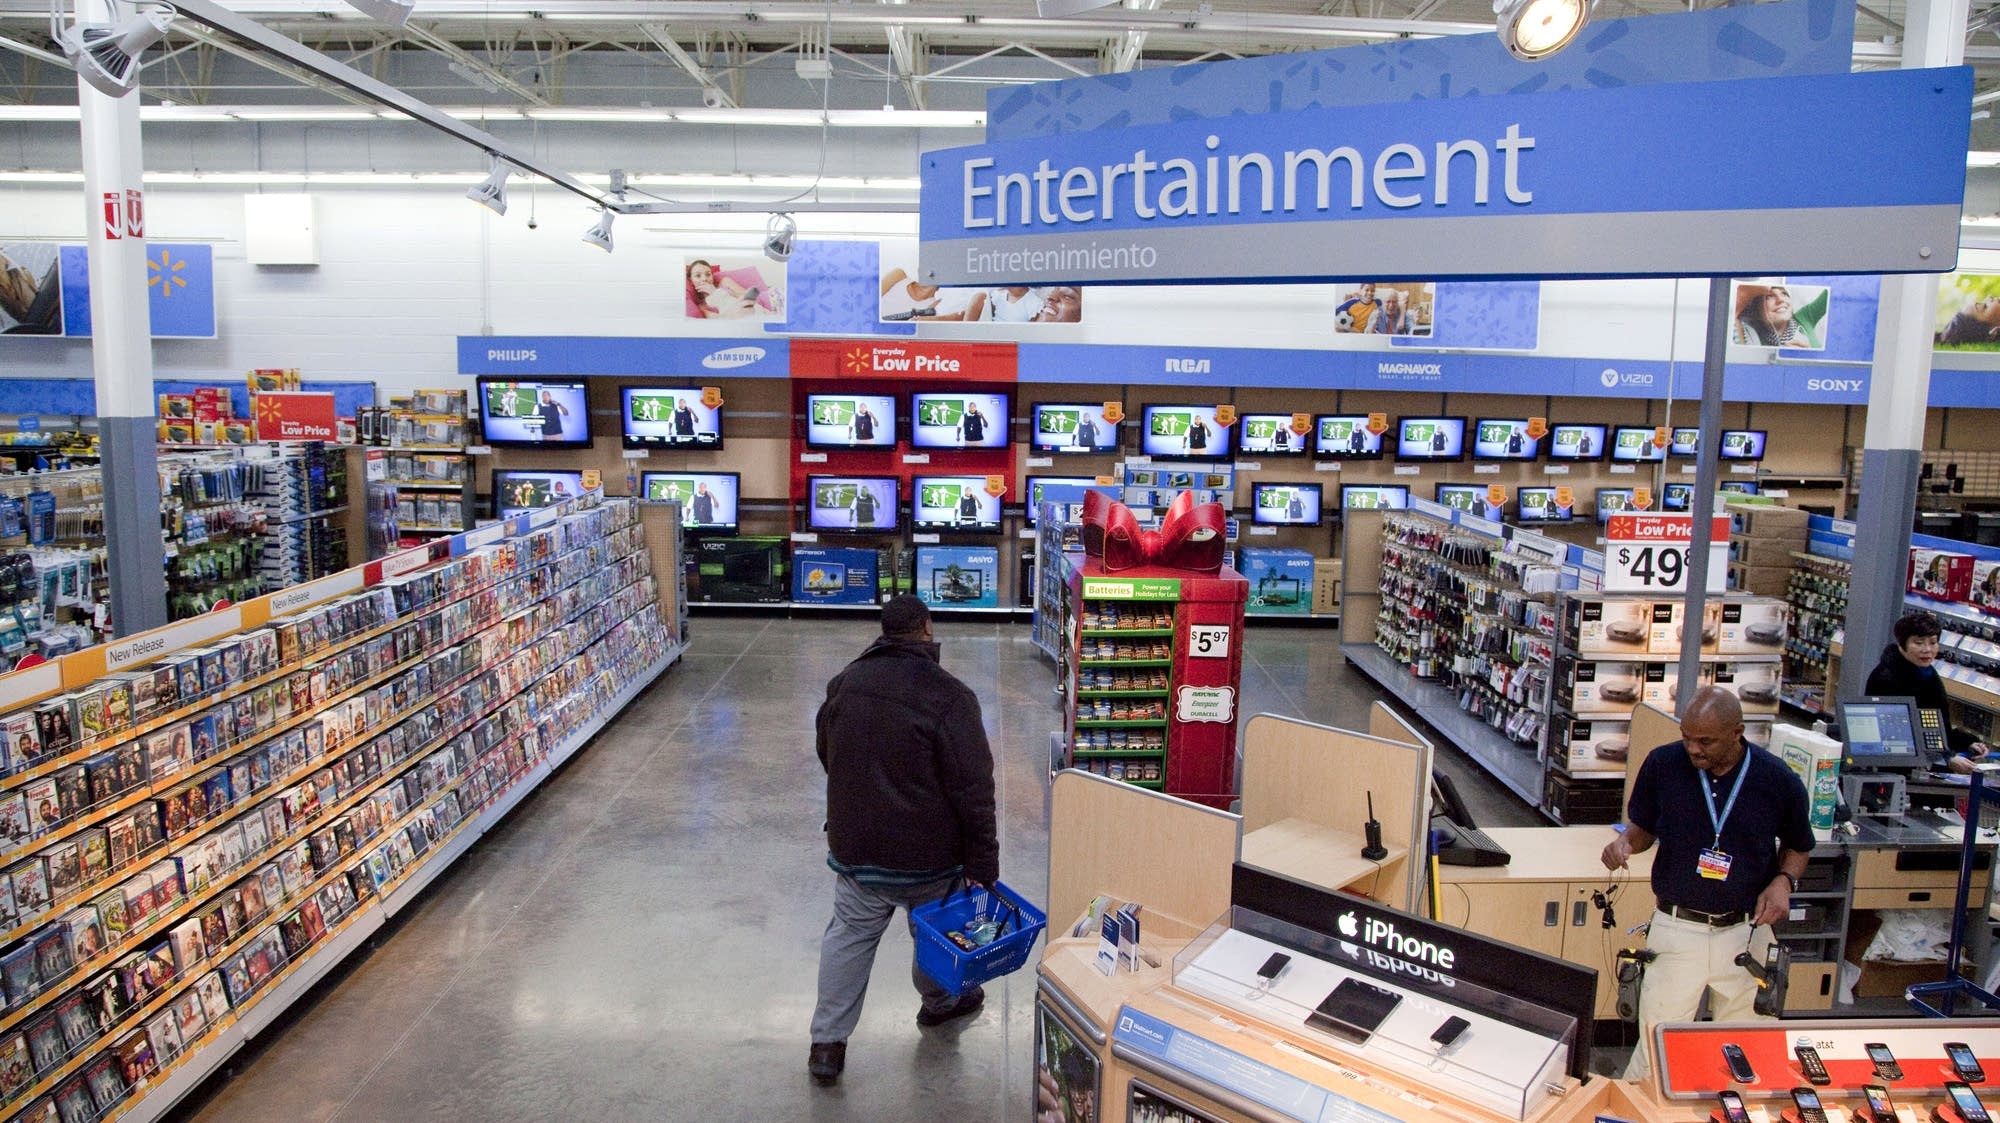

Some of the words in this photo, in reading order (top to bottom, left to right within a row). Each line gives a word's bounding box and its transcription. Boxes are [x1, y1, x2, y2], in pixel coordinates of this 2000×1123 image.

[963, 123, 1536, 229] Entertainment
[966, 242, 1157, 274] Entretenimiento
[487, 349, 537, 361] PHILIPS
[710, 352, 760, 362] SAMSUNG
[872, 347, 906, 357] Everyday
[873, 355, 911, 371] Low
[914, 355, 960, 372] Price
[1165, 358, 1210, 374] RCA
[1378, 362, 1441, 375] MAGNAVOX
[1620, 373, 1654, 384] VIZIO
[1807, 378, 1864, 392] SONY
[281, 426, 303, 435] Low
[304, 425, 331, 436] Price
[1636, 517, 1662, 525] Everyday
[1635, 523, 1665, 536] Low
[1666, 523, 1692, 537] Pric
[967, 556, 993, 564] SANYO
[1088, 585, 1132, 595] Batteries
[272, 599, 286, 610] New
[287, 590, 310, 604] Release
[109, 648, 131, 664] New
[132, 636, 165, 657] Release
[1364, 916, 1455, 969] iPhone
[1815, 1040, 1834, 1049] at&t
